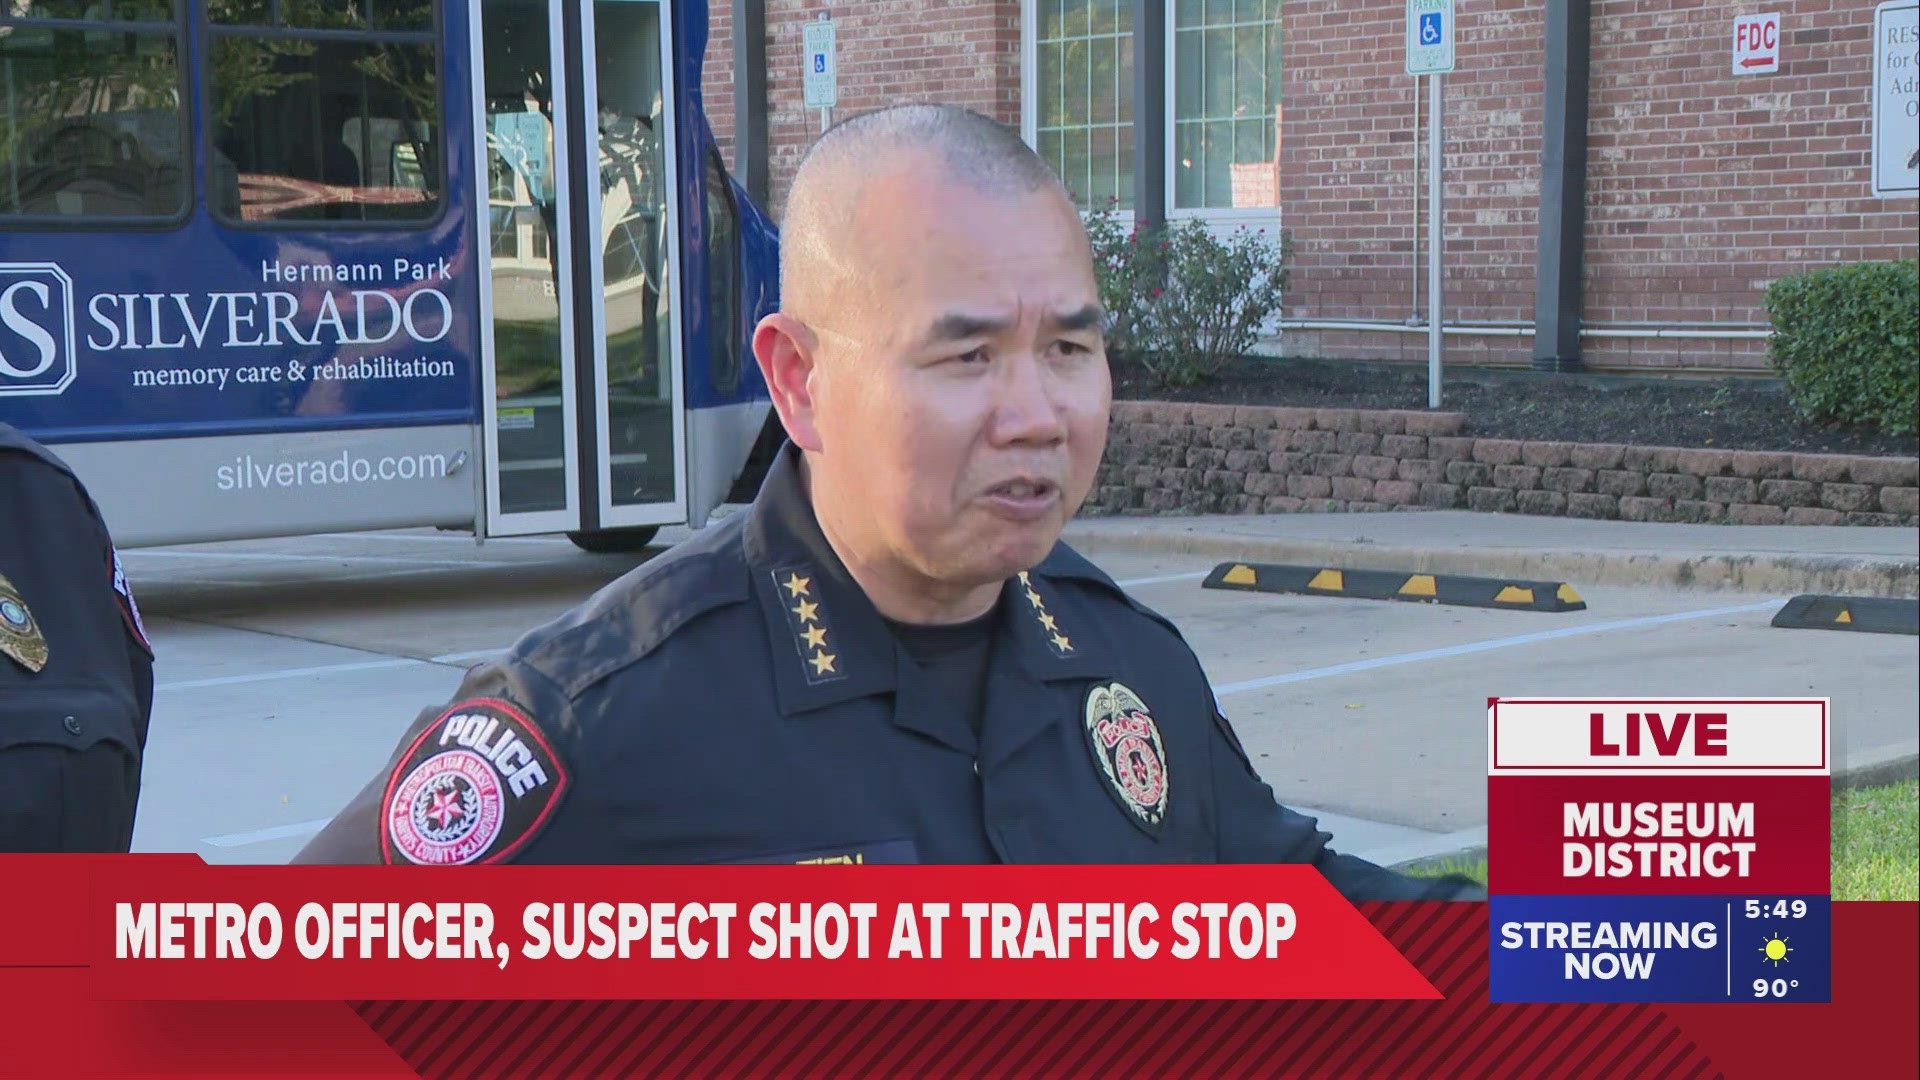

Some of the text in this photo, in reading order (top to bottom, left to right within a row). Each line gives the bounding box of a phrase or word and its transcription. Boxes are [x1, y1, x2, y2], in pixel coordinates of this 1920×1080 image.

[1736, 20, 1776, 52] FDC
[1887, 52, 1910, 69] for
[262, 257, 452, 283] Hermann Park
[87, 288, 453, 351] SILVERADO
[133, 355, 455, 391] memory care & rehabilitation
[216, 450, 446, 490] silverado.com
[439, 714, 548, 799] POLICE
[414, 842, 457, 863] COUNTY
